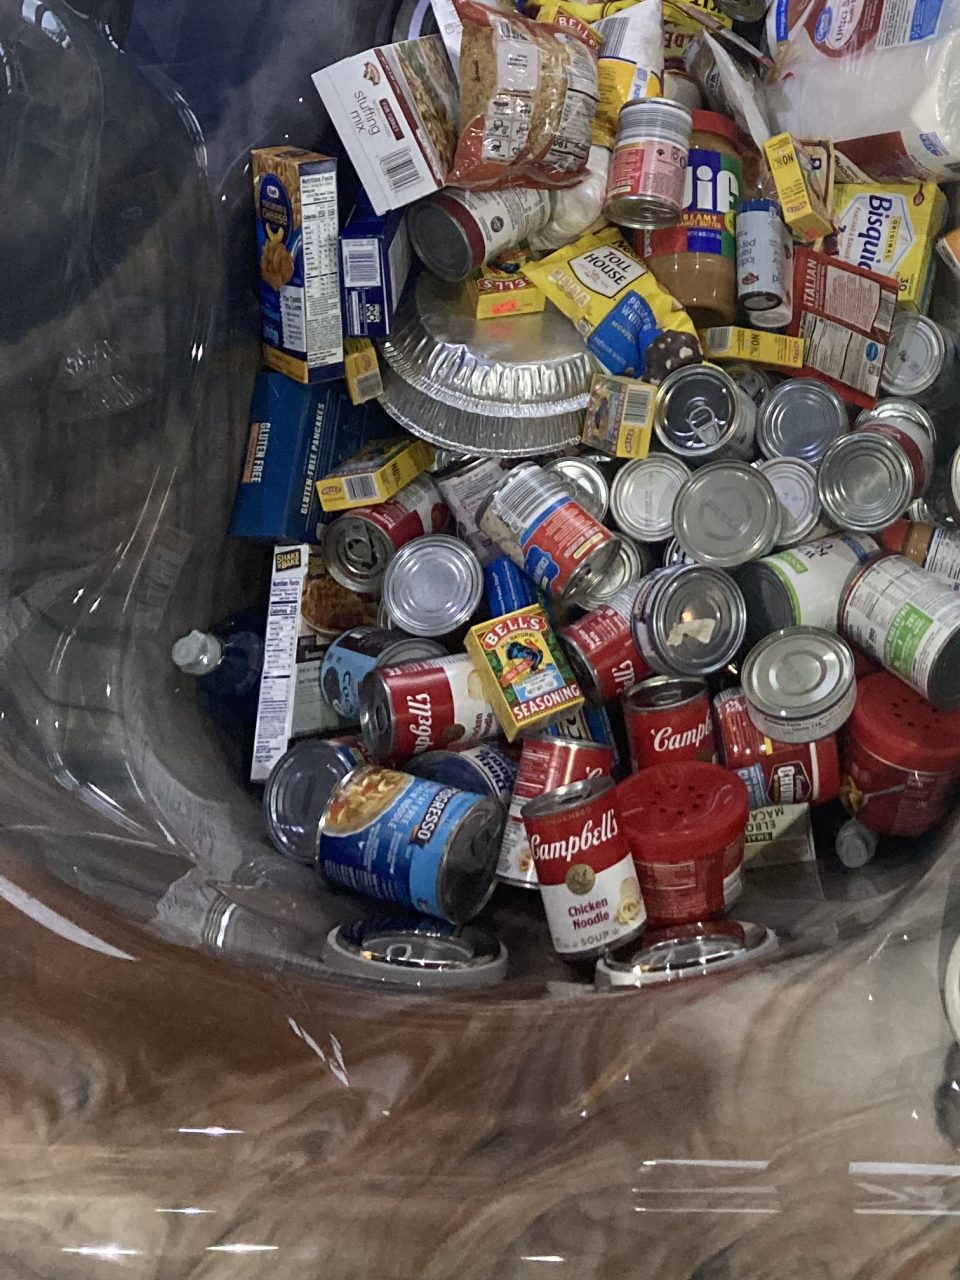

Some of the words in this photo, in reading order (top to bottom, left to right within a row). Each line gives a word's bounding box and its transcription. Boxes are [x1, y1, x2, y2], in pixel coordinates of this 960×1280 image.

[559, 16, 597, 49] BELL'S
[350, 110, 366, 132] mix
[354, 90, 380, 136] stuffing
[385, 111, 402, 137] TURKEY
[301, 176, 320, 184] Nutrition
[320, 175, 334, 183] Facts
[682, 165, 739, 213] Jif
[683, 214, 718, 223] REAMY
[884, 218, 899, 262] ORIGINAL
[583, 254, 628, 286] HOUSE
[601, 251, 632, 273] TOLL
[803, 258, 818, 306] ITALIAN
[255, 422, 271, 455] GLUTEN
[251, 457, 264, 483] FREE
[301, 451, 318, 514] GLUTEN-FREE
[311, 403, 326, 450] PANCAKES
[276, 551, 300, 563] SHAKE
[281, 558, 300, 569] BAKE
[485, 617, 541, 646] BELL'S
[510, 633, 535, 642] NATURAL
[513, 684, 580, 720] SEASONING
[531, 808, 618, 862] Campbell's
[745, 820, 776, 833] ELBO
[568, 897, 608, 918] Chicken
[573, 911, 610, 930] Noodle
[580, 931, 609, 947] SOUP
